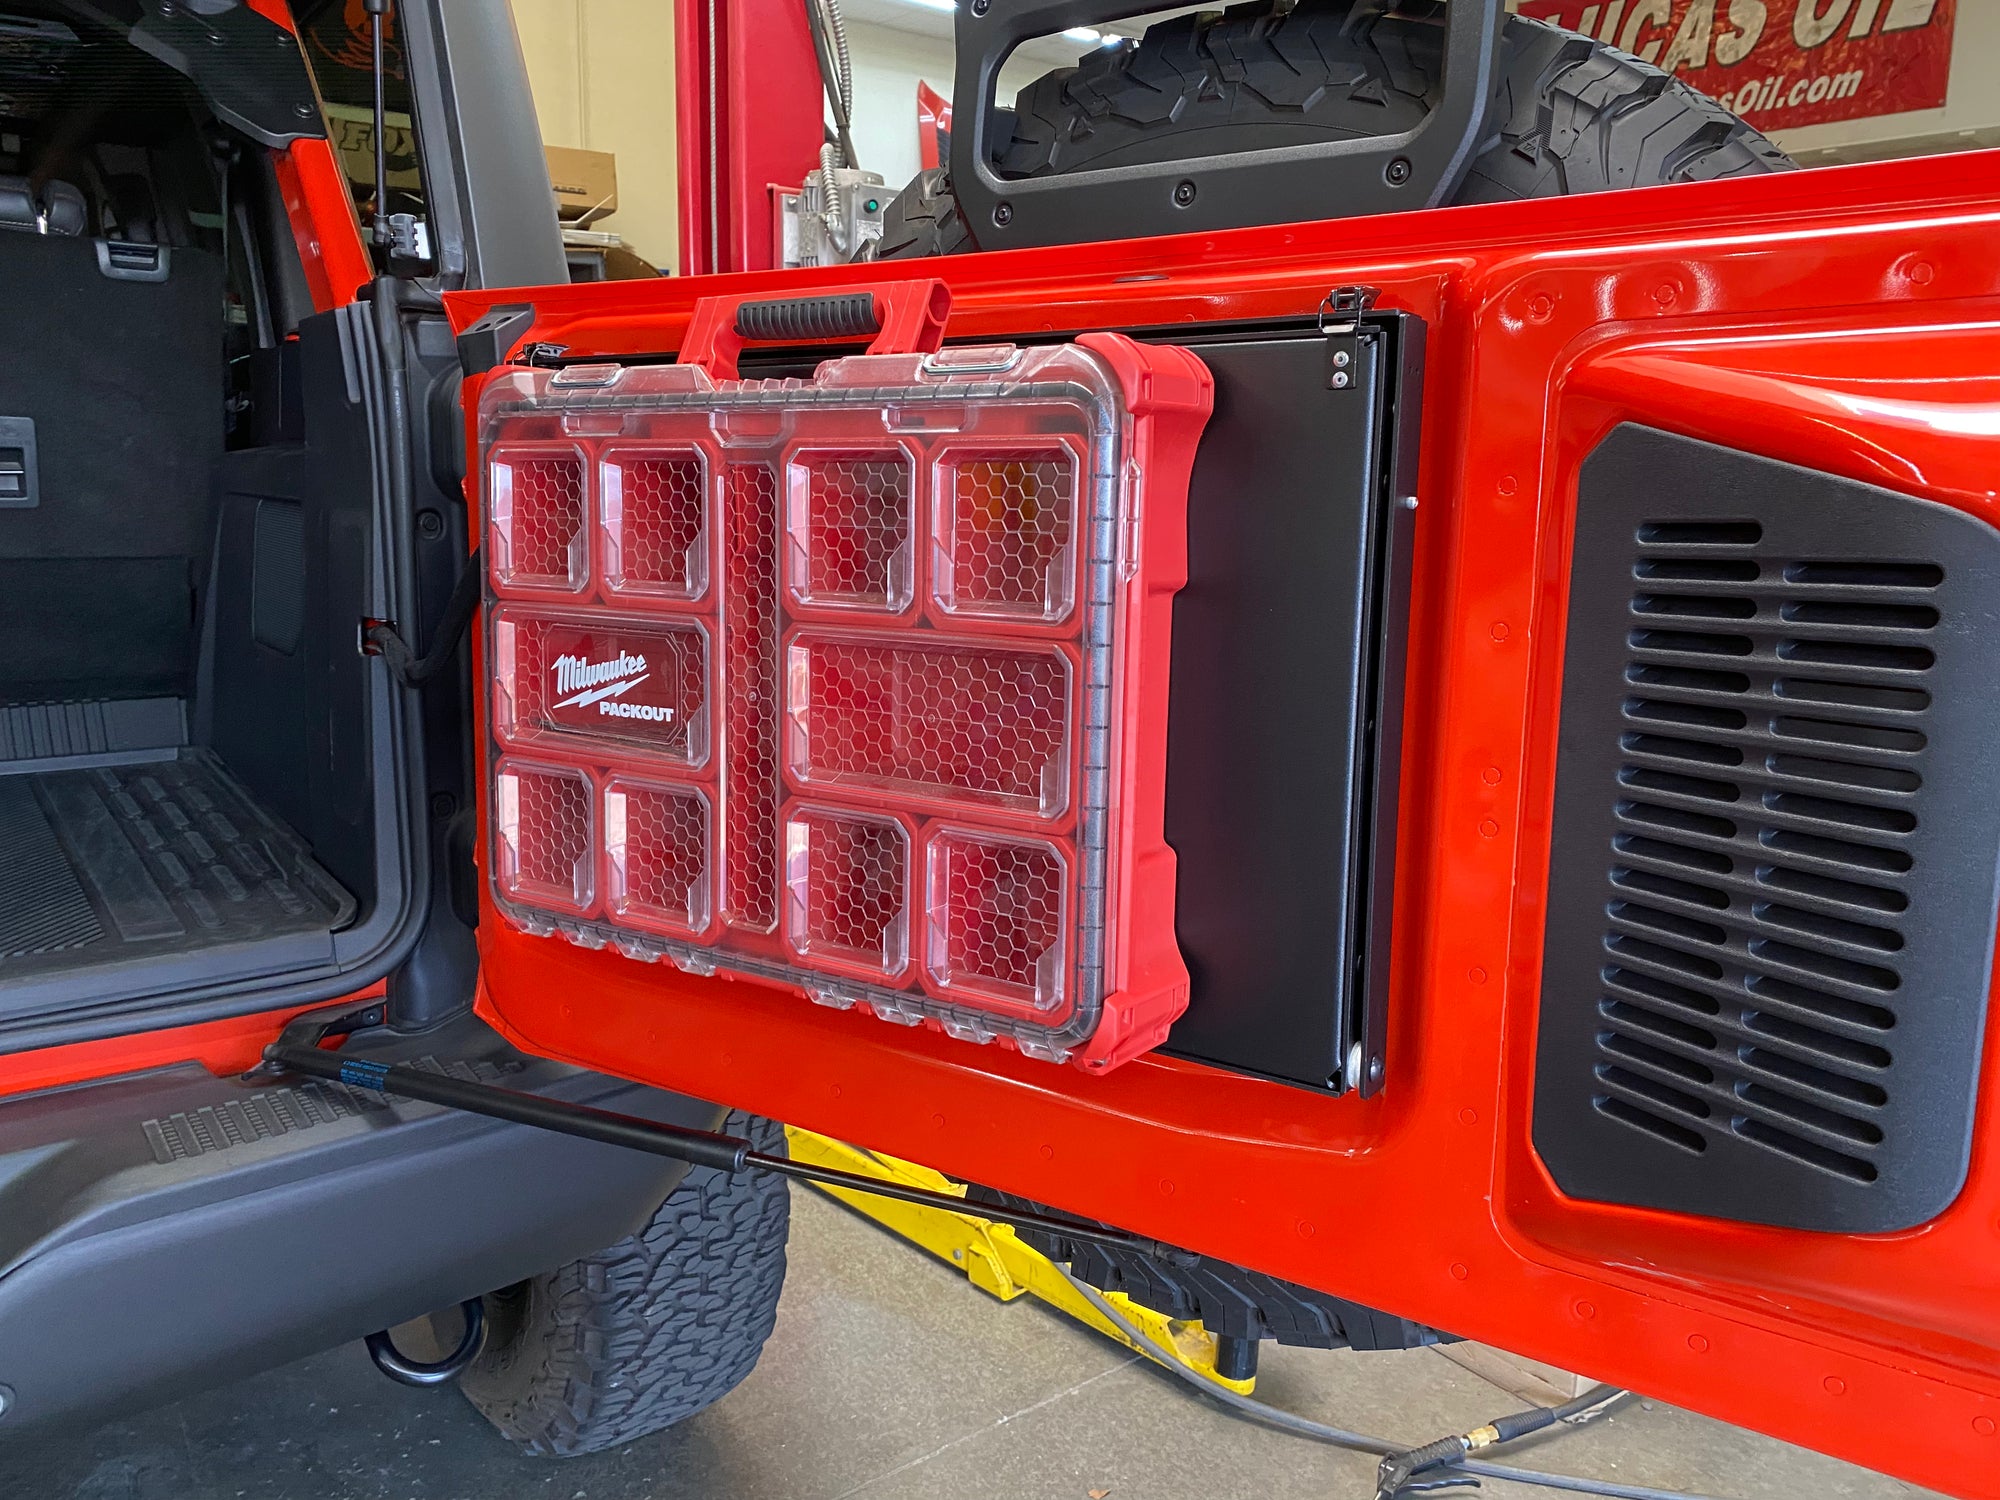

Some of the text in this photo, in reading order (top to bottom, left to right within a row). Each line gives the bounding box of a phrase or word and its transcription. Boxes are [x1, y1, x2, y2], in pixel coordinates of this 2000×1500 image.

[1792, 0, 1937, 49] OIL
[551, 650, 647, 696] Milwaukee
[600, 701, 674, 722] PACKOUT
